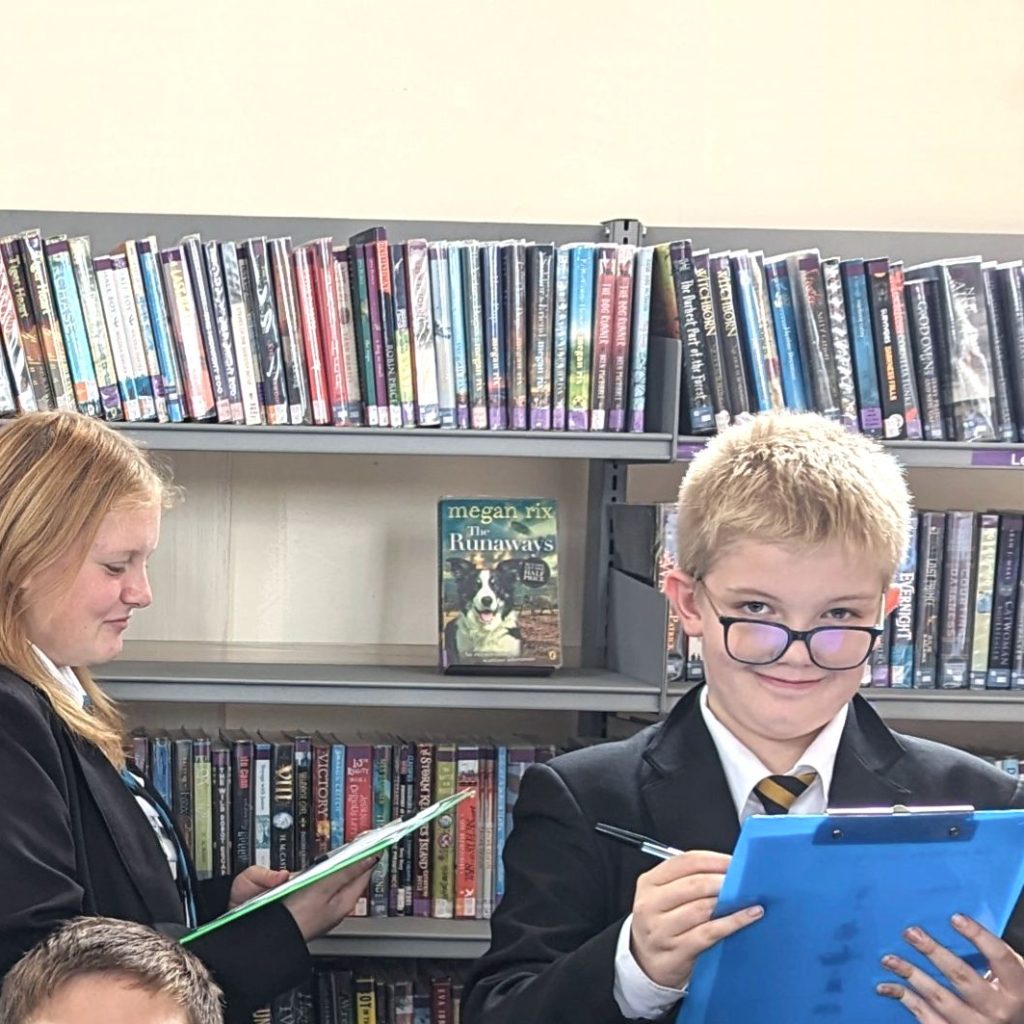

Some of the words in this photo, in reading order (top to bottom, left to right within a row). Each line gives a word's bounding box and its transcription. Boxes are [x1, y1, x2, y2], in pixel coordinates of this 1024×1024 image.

[8, 255, 24, 287] Tiger
[16, 288, 29, 319] Heart
[600, 283, 612, 298] THE
[618, 285, 629, 299] THE
[681, 280, 694, 293] The
[600, 298, 612, 314] DOG
[617, 300, 629, 315] DOG
[682, 295, 698, 327] Darkest
[694, 267, 716, 336] WITCHBORN
[717, 270, 737, 338] WITCHBORN
[599, 315, 611, 344] RUNNER
[616, 317, 628, 346] RUNNER
[916, 301, 931, 334] GOOD
[687, 328, 700, 346] Part
[386, 344, 395, 373] ROBIN
[473, 344, 482, 375] megan
[490, 337, 500, 368] megan
[535, 341, 546, 373] megan
[575, 336, 584, 368] megan
[689, 349, 700, 358] of
[918, 336, 934, 376] OMENS
[576, 371, 586, 385] rix
[692, 361, 703, 373] the
[475, 377, 483, 392] rix
[693, 374, 707, 401] Forest
[448, 505, 518, 524] megan
[525, 503, 553, 519] rix
[449, 533, 554, 555] Runaways
[467, 526, 490, 537] The
[896, 572, 915, 641] EVERNIGHT
[947, 568, 957, 638] DARKNESS
[667, 615, 679, 650] PATRICK
[1000, 600, 1013, 666] CATWOMAN
[274, 763, 293, 802] VIII
[317, 752, 329, 817] VICTORY
[420, 757, 431, 792] STORM
[420, 839, 430, 869] ISLAND
[437, 988, 447, 1006] EVA
